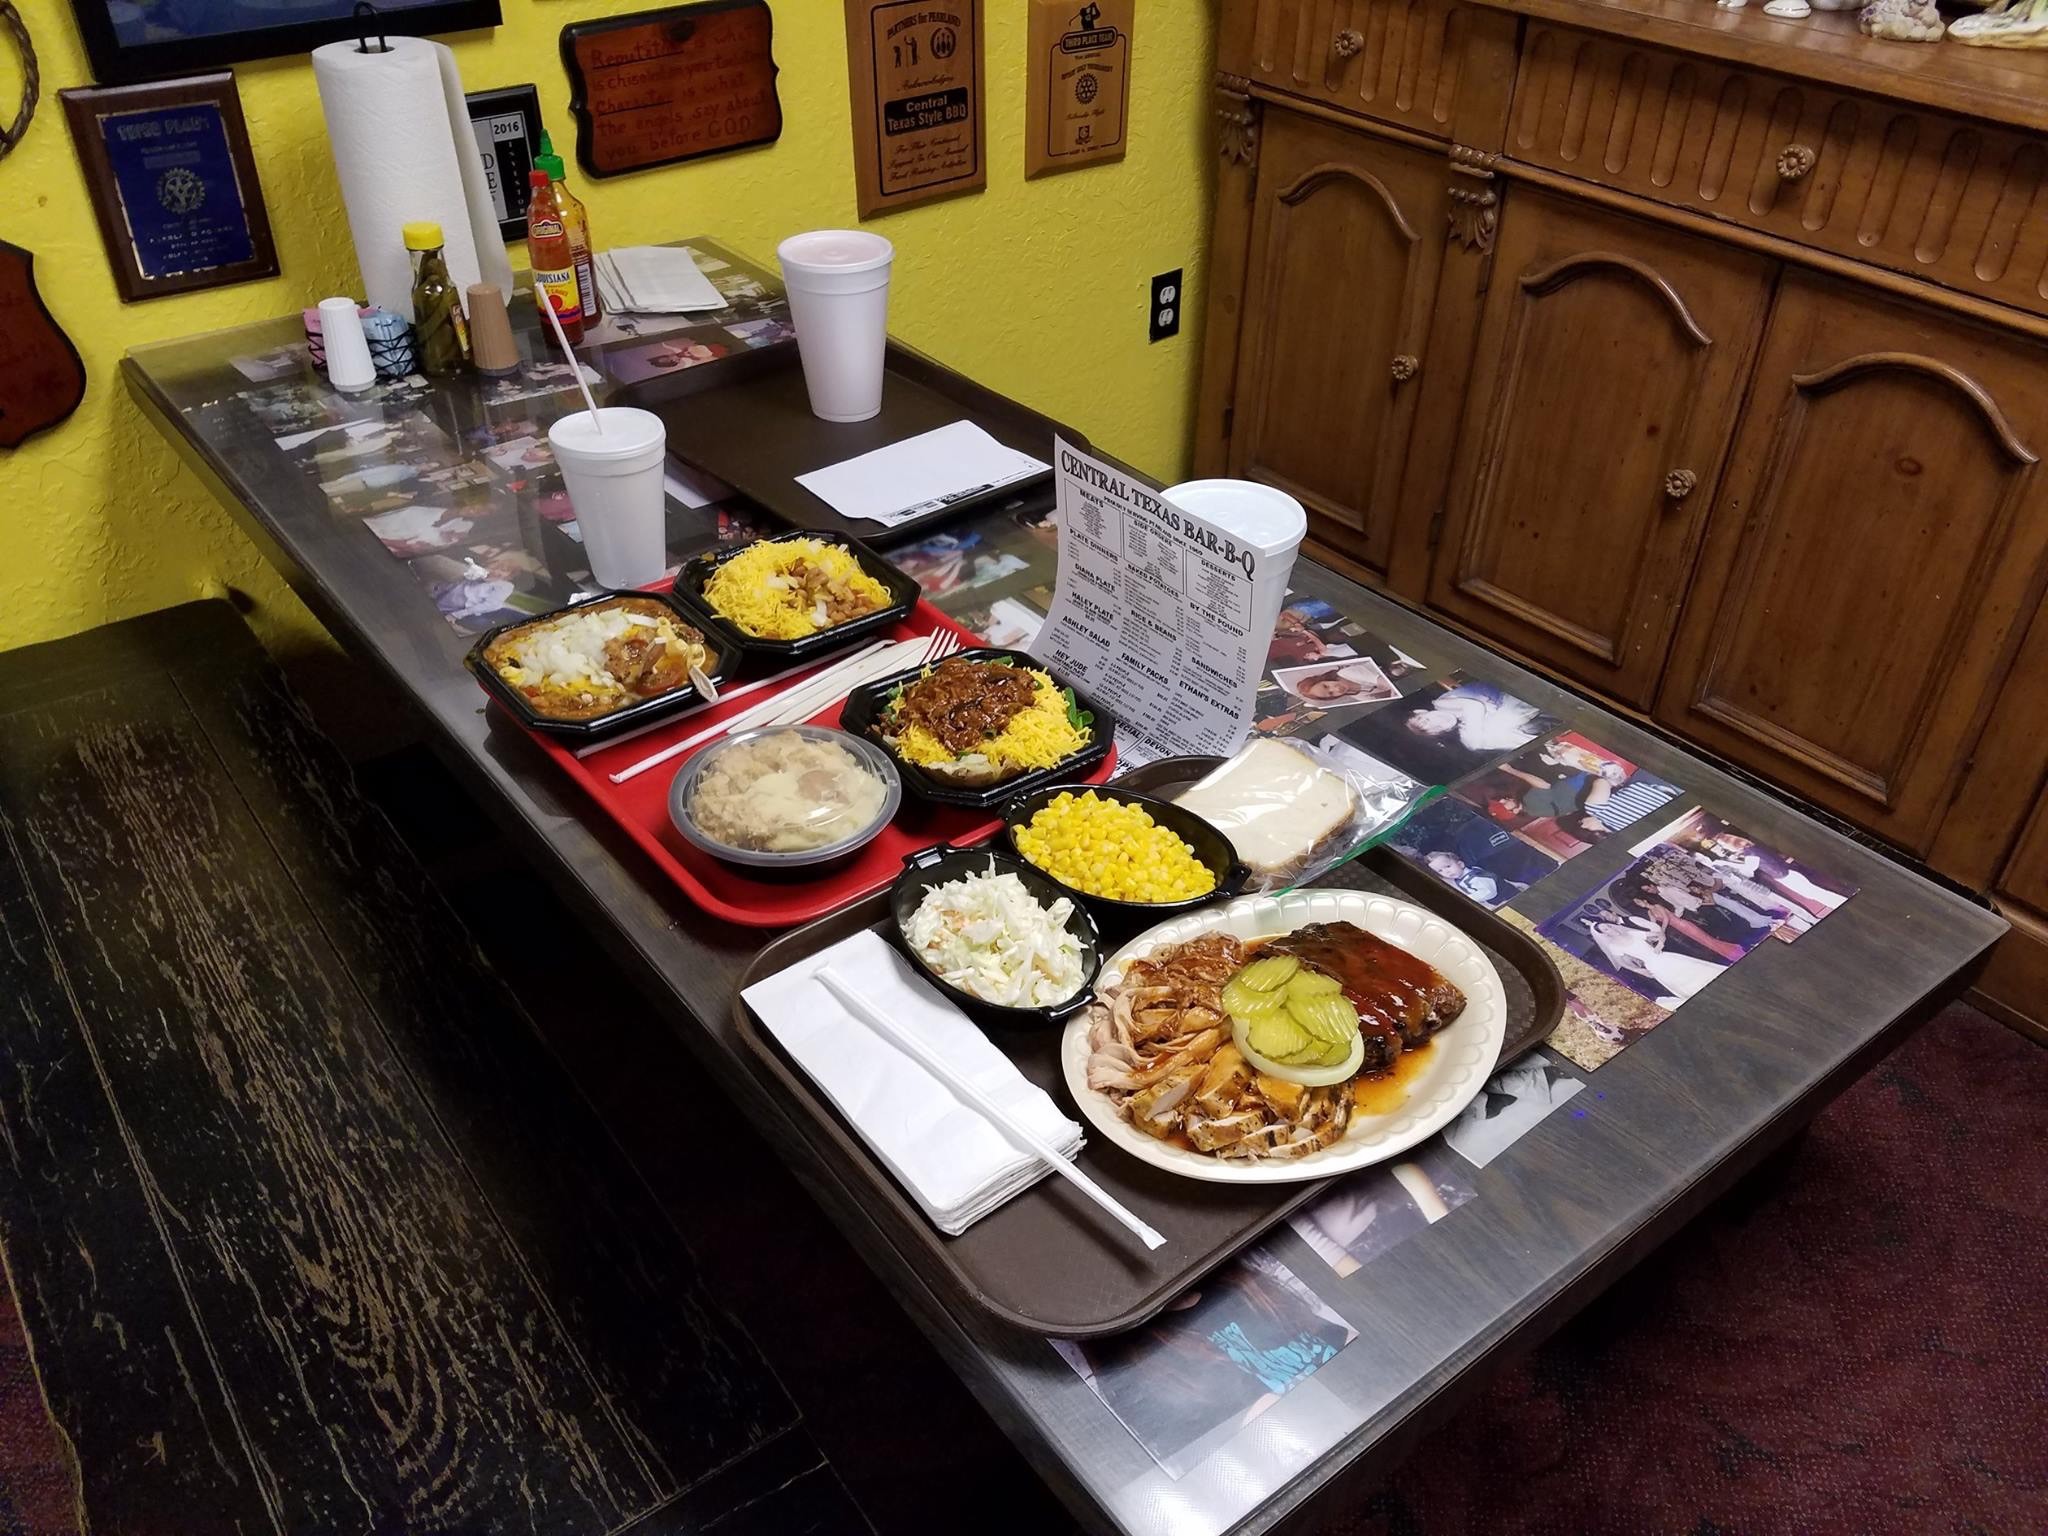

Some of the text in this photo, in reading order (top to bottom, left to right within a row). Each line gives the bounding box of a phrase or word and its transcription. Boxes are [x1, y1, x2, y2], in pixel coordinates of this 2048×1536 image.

[887, 103, 967, 131] Texas Style BBQ
[906, 95, 948, 112] Central
[494, 121, 520, 135] 2016
[1080, 489, 1104, 508] MEATS
[1061, 449, 1130, 502] CENTRAL
[1131, 487, 1181, 531] TEXAS
[1183, 519, 1256, 582] BAR-B-Q
[1069, 528, 1089, 545] PLATE
[1090, 539, 1118, 562] DINNERS
[1133, 520, 1149, 531] SIDE
[1149, 527, 1173, 547] ORDERS
[1075, 563, 1095, 580] DIANA
[1095, 575, 1116, 592] PLATE
[1127, 564, 1148, 579] BAKED
[1149, 575, 1179, 598] POTATOES
[1201, 559, 1236, 582] DESSERTS
[1072, 592, 1093, 608] HALEY
[1094, 604, 1114, 620] PLATE
[1189, 602, 1244, 637] BY THE POUND
[1062, 615, 1089, 635] ASHLEY
[1088, 630, 1111, 648] SALAD
[1130, 609, 1147, 624] RICE
[1154, 623, 1177, 641] BEANS
[1055, 649, 1071, 662] HEY
[1070, 658, 1089, 673] JUDE
[1121, 652, 1146, 671] FAMILY
[1146, 667, 1169, 685] PACKS
[1191, 657, 1238, 688] SANDWICHES
[1179, 680, 1210, 702] ETHAN'S
[1210, 699, 1240, 720] EXTRAS
[1115, 719, 1142, 739] PECIAL
[1144, 738, 1172, 757] DEVON
